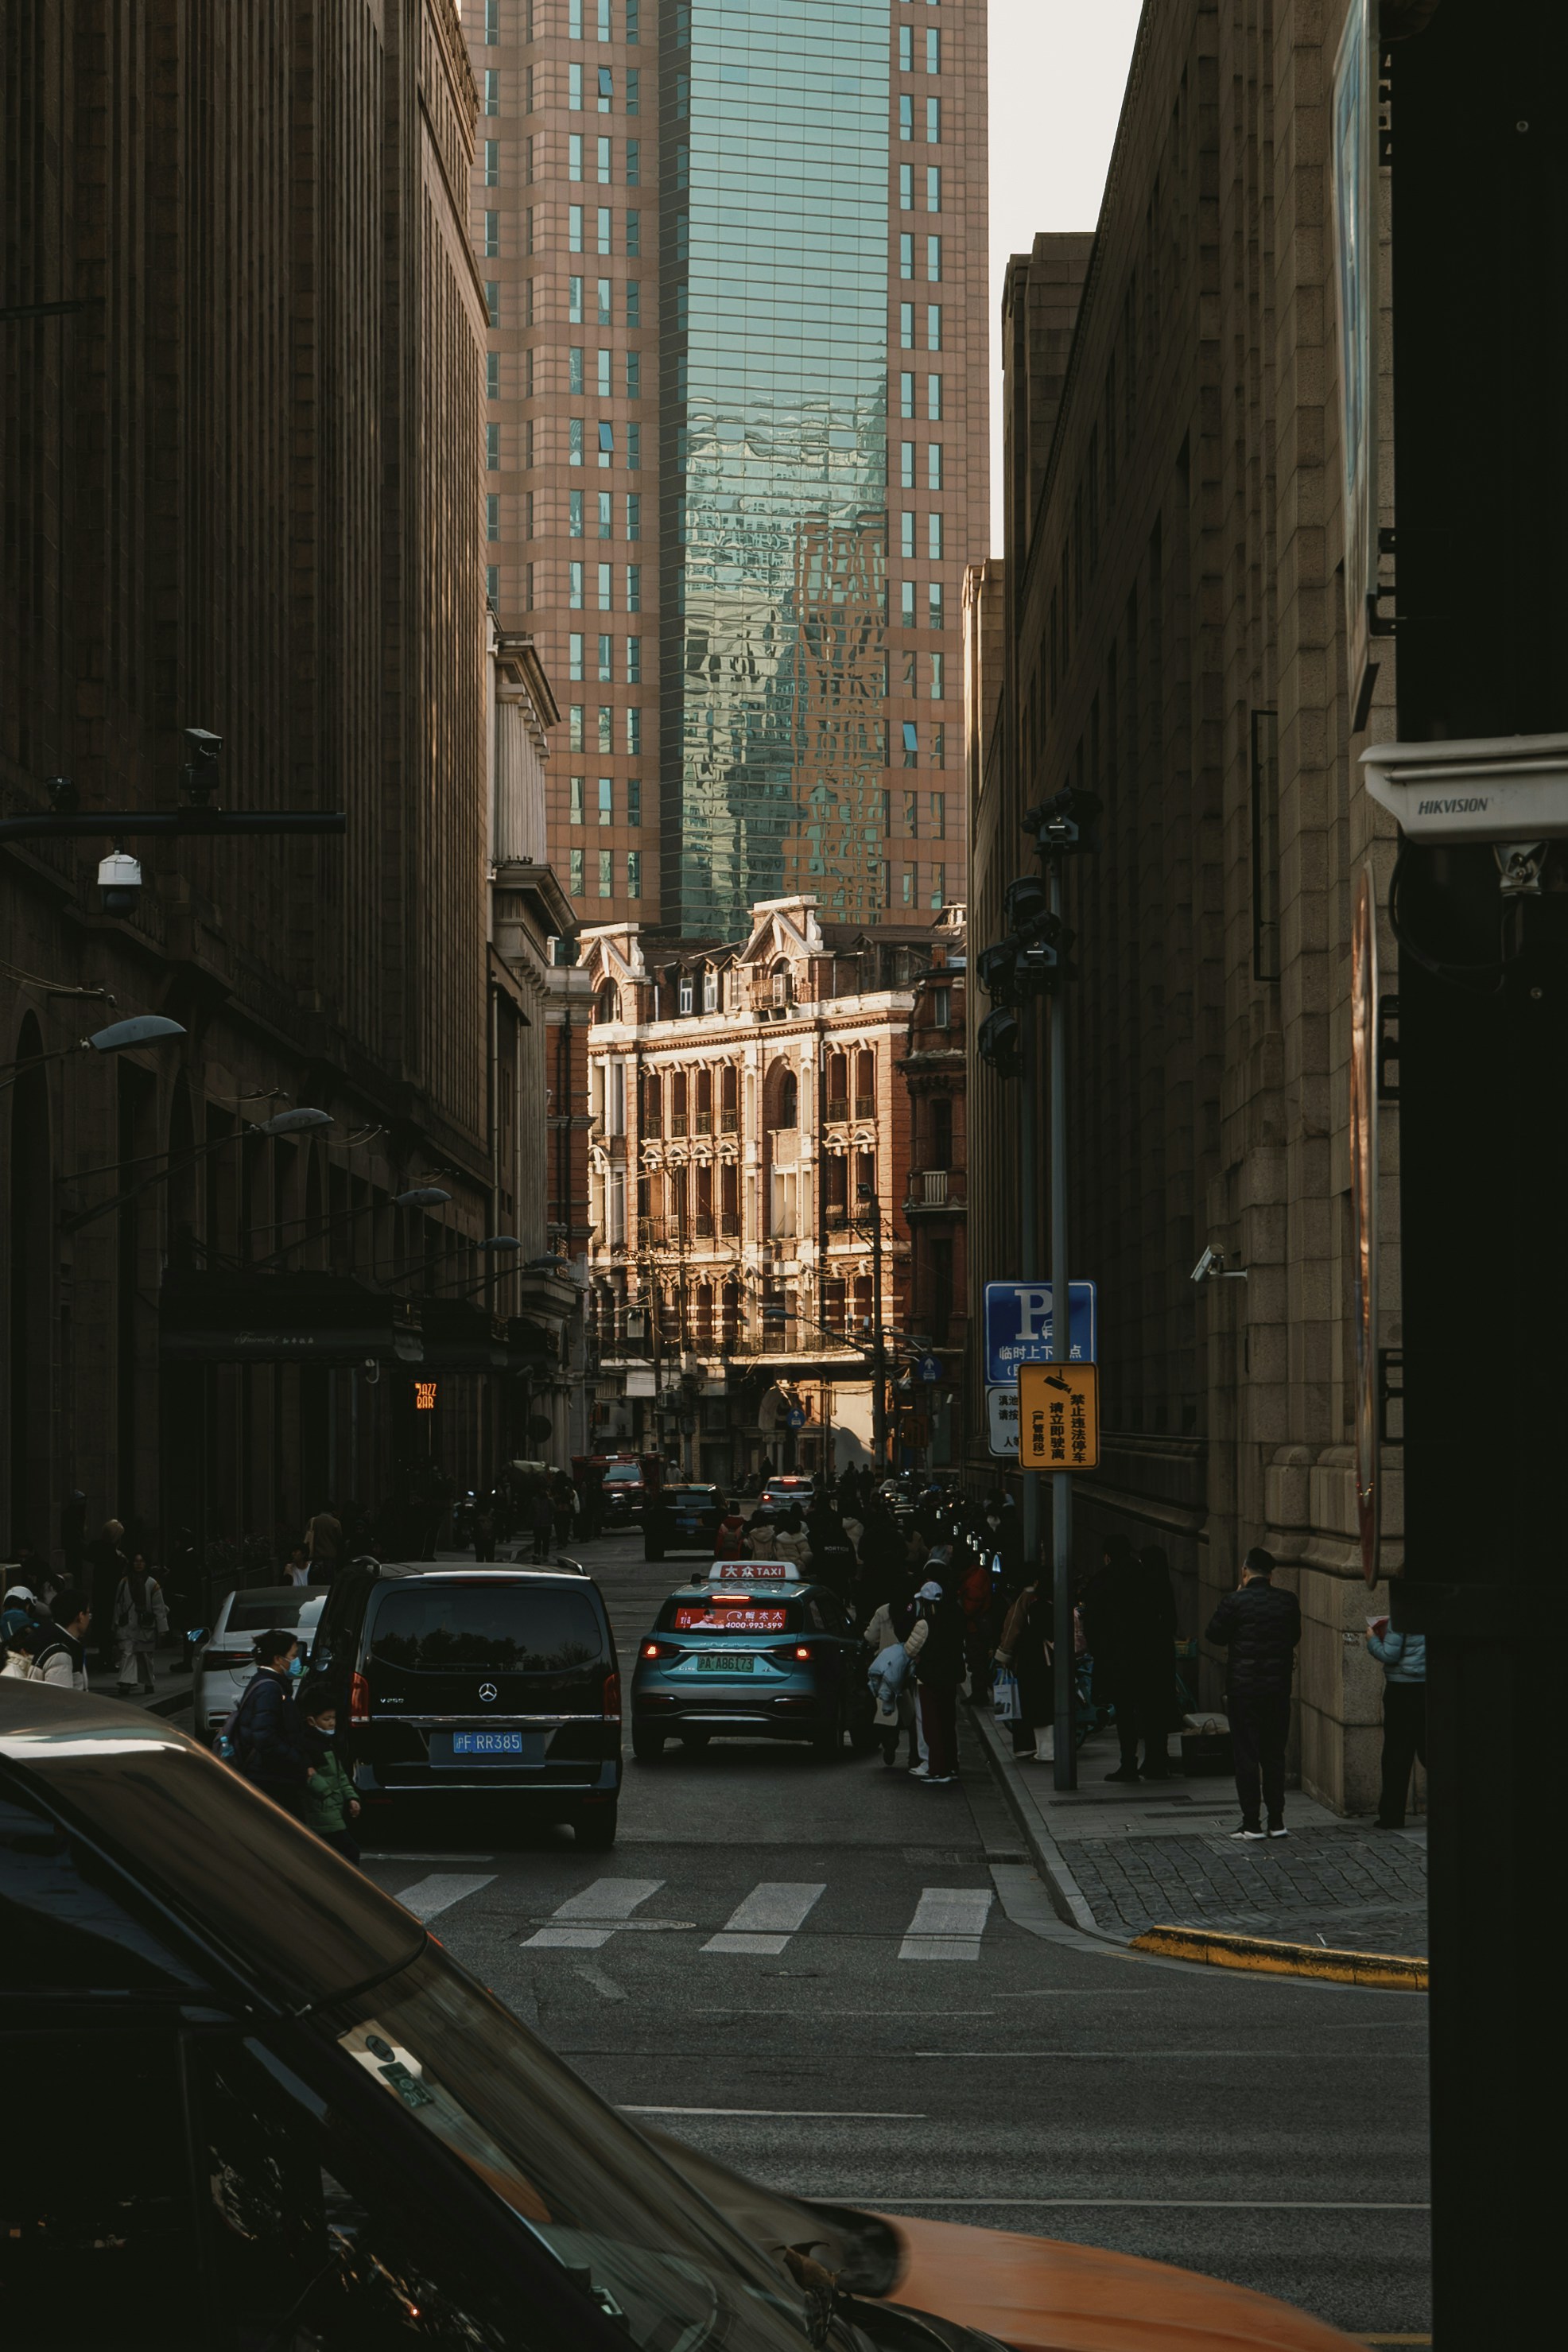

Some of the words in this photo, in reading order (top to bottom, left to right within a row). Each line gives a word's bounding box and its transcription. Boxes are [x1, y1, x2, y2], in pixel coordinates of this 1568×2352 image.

[1419, 798, 1488, 815] HIKVISION
[1015, 1289, 1053, 1340] P
[999, 1345, 1081, 1360] 临时上下点
[417, 1395, 434, 1409] BAR
[1050, 1402, 1065, 1460] 请立即驶离
[1070, 1394, 1087, 1463] 禁止违法停车
[724, 1566, 755, 1578] 大众
[756, 1567, 782, 1576] TAXI
